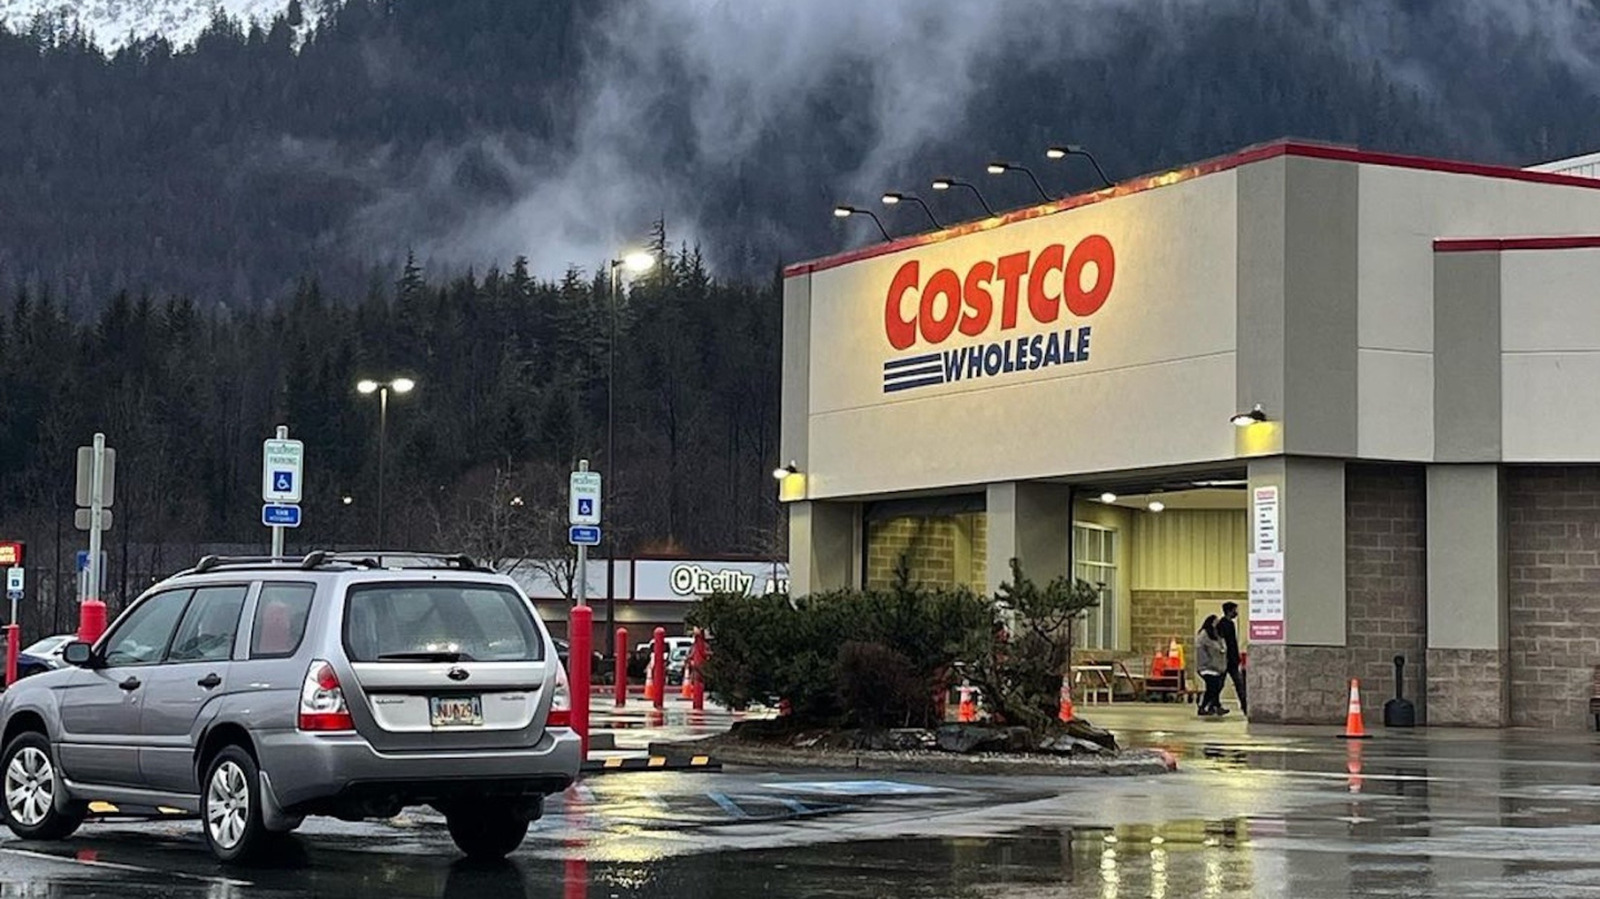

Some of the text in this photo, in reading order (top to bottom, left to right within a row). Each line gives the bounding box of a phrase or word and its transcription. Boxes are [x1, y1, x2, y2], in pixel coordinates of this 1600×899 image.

[885, 234, 1115, 350] COSTCO
[943, 326, 1091, 382] WHOLESALE
[670, 563, 754, 598] O'Reilly
